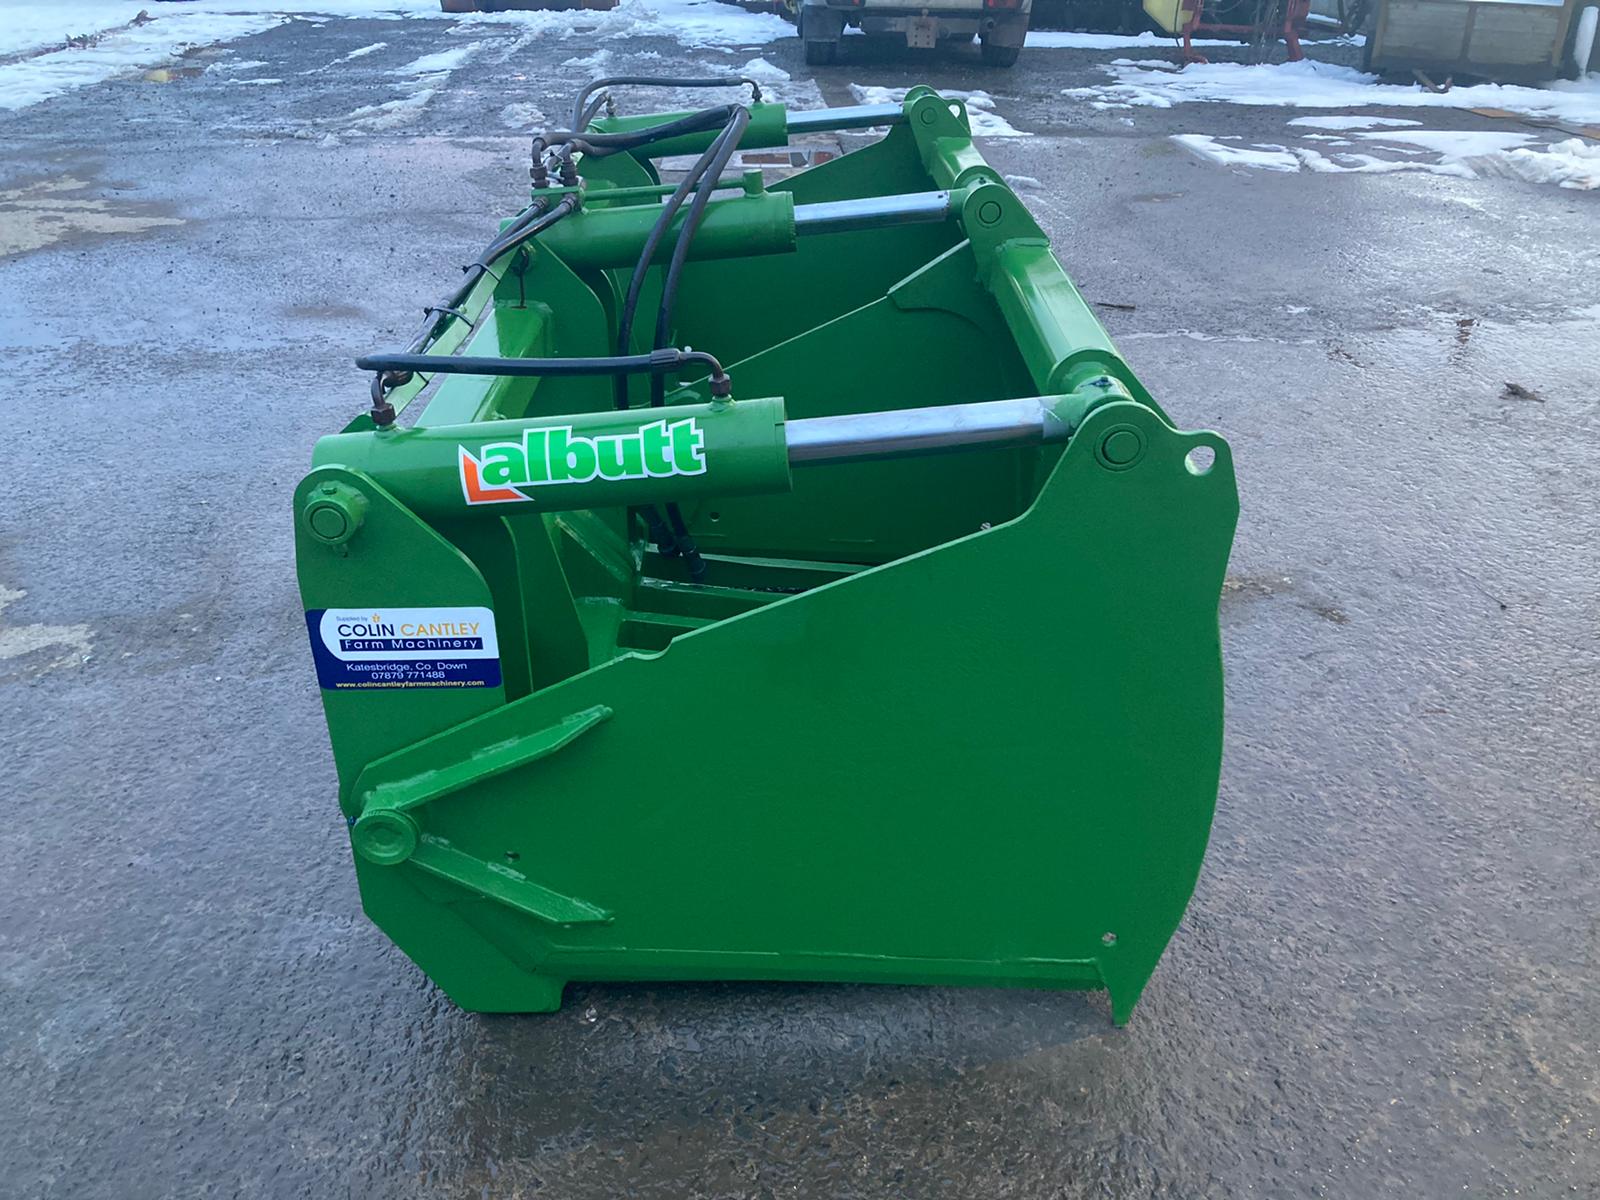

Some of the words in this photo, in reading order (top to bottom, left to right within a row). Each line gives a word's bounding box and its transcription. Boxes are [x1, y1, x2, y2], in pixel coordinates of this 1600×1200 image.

[481, 418, 706, 486] albutt
[338, 623, 395, 637] COLIN
[400, 622, 480, 636] CANTLEY
[344, 639, 384, 649] Farm
[391, 638, 477, 649] Machinery
[415, 663, 434, 671] Co.
[437, 662, 468, 670] Down
[371, 671, 404, 679] 07879
[407, 671, 446, 679] 771488
[335, 680, 485, 689] www.colincantleyfarmmachinery.com
